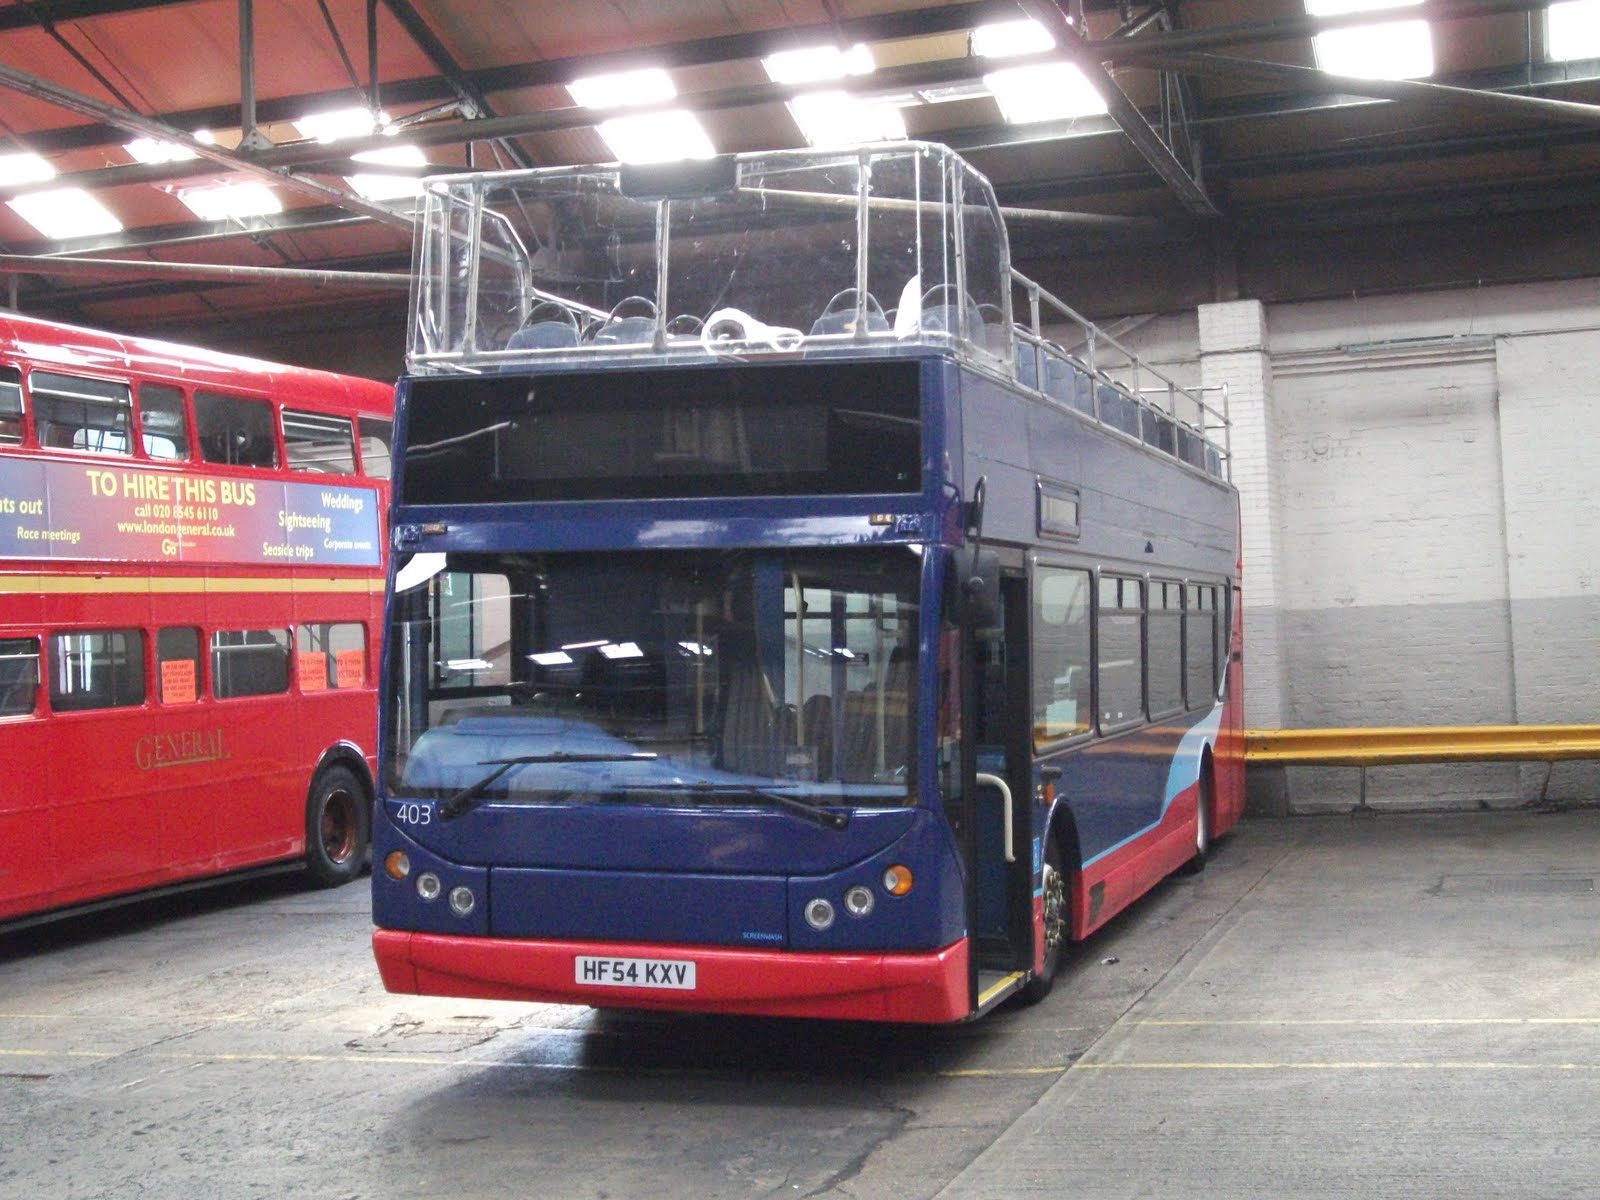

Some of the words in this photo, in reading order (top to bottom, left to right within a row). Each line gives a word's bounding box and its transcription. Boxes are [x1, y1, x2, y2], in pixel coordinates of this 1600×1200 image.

[86, 470, 117, 497] TO
[122, 473, 170, 501] HIRE
[171, 476, 217, 504] THIS
[220, 480, 256, 506] BUS
[19, 499, 43, 515] out
[134, 503, 151, 518] call
[153, 504, 170, 518] 020
[196, 506, 218, 521] 6110
[321, 492, 364, 514] Weddings
[117, 520, 236, 538] www.londongeneral.co.uk
[278, 510, 331, 533] Sightseeing
[16, 526, 40, 540] Race
[41, 529, 81, 545] meetings
[262, 541, 294, 557] Seaside
[295, 544, 314, 561] trips
[135, 728, 232, 772] GENERAL
[396, 804, 431, 825] 403
[583, 960, 639, 983] HF54
[645, 962, 687, 985] KXV
